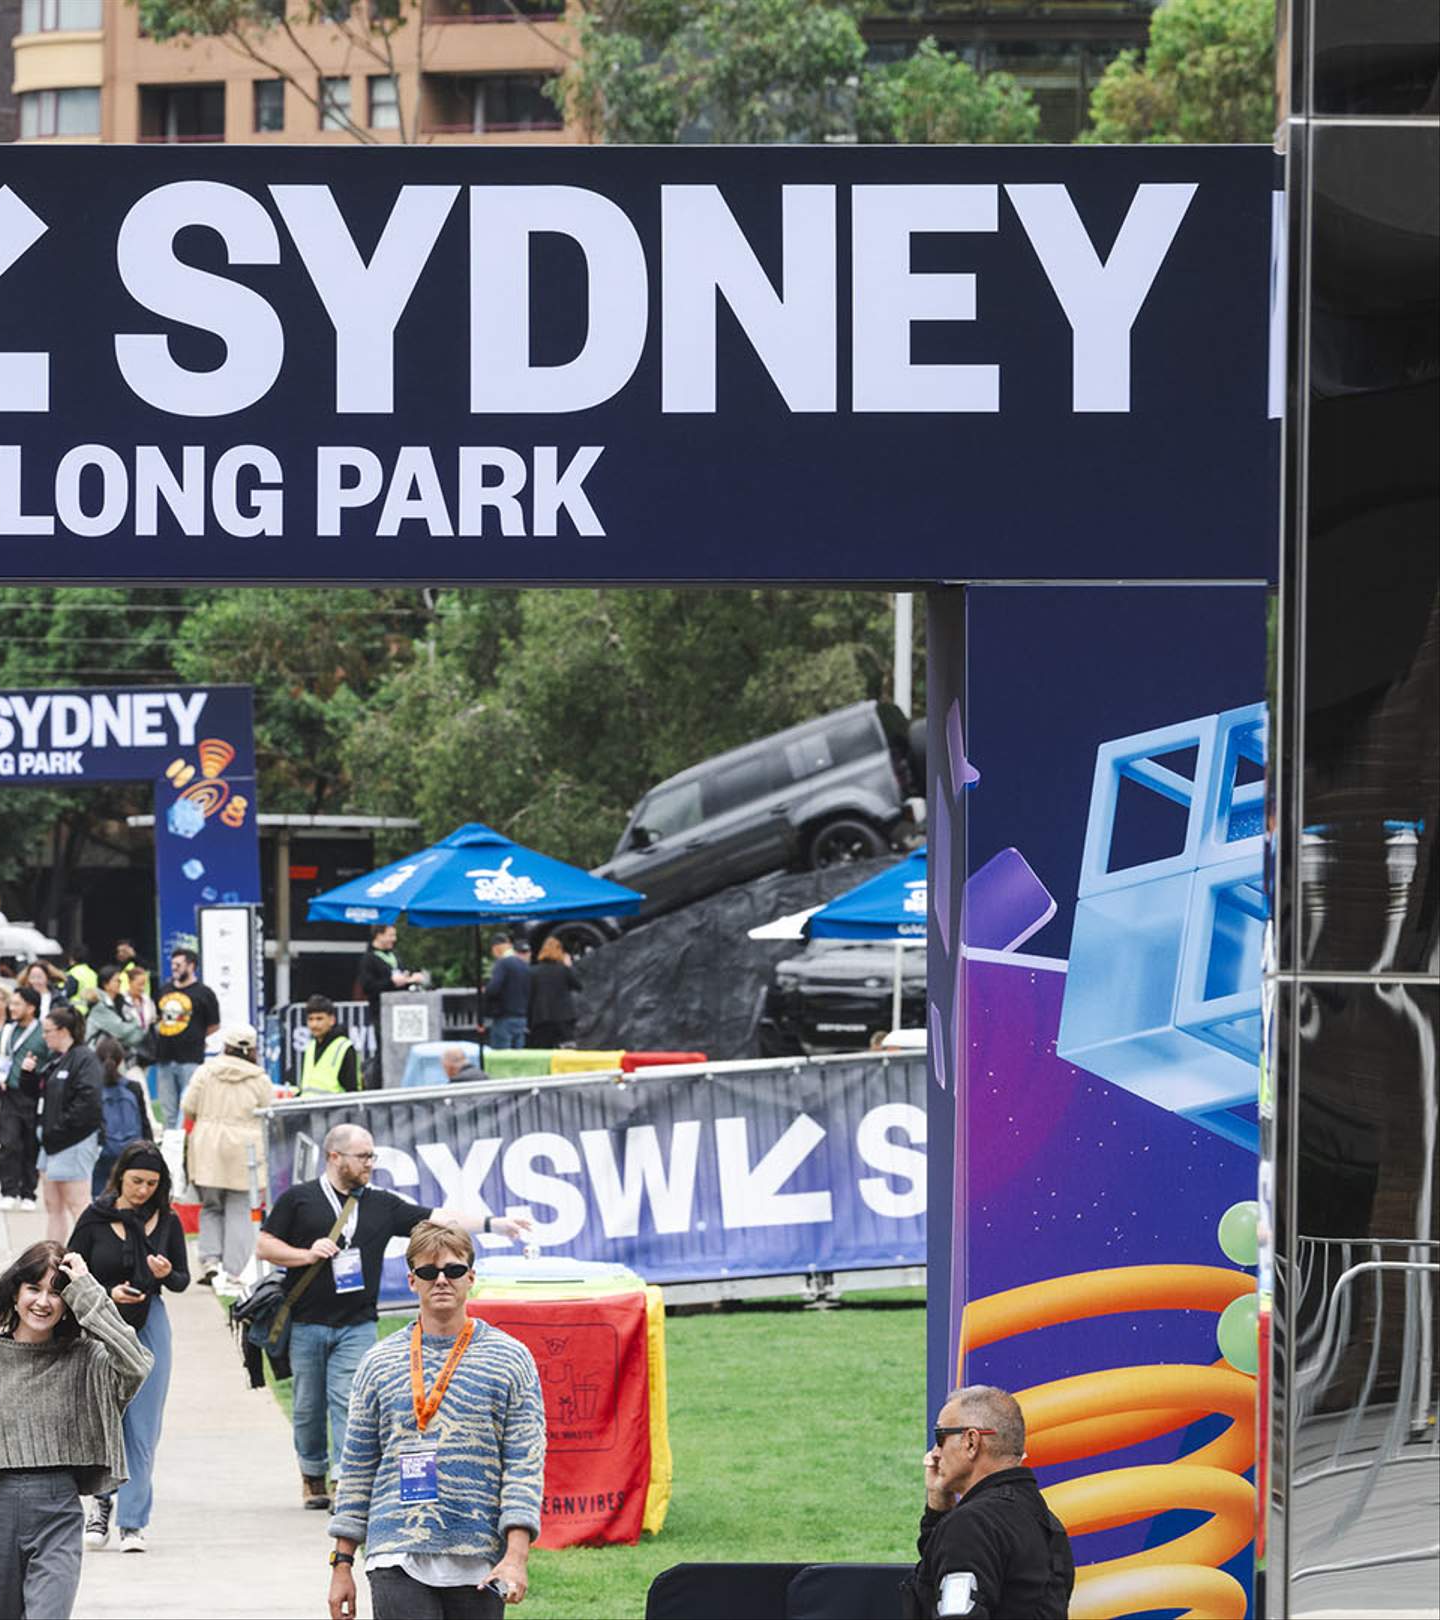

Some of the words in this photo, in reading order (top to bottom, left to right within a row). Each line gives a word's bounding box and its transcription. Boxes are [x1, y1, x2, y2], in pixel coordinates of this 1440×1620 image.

[115, 181, 1198, 416] SYDNEY
[318, 447, 605, 535] PARK
[18, 751, 83, 775] PARK
[542, 1490, 626, 1516] EANVIBES
